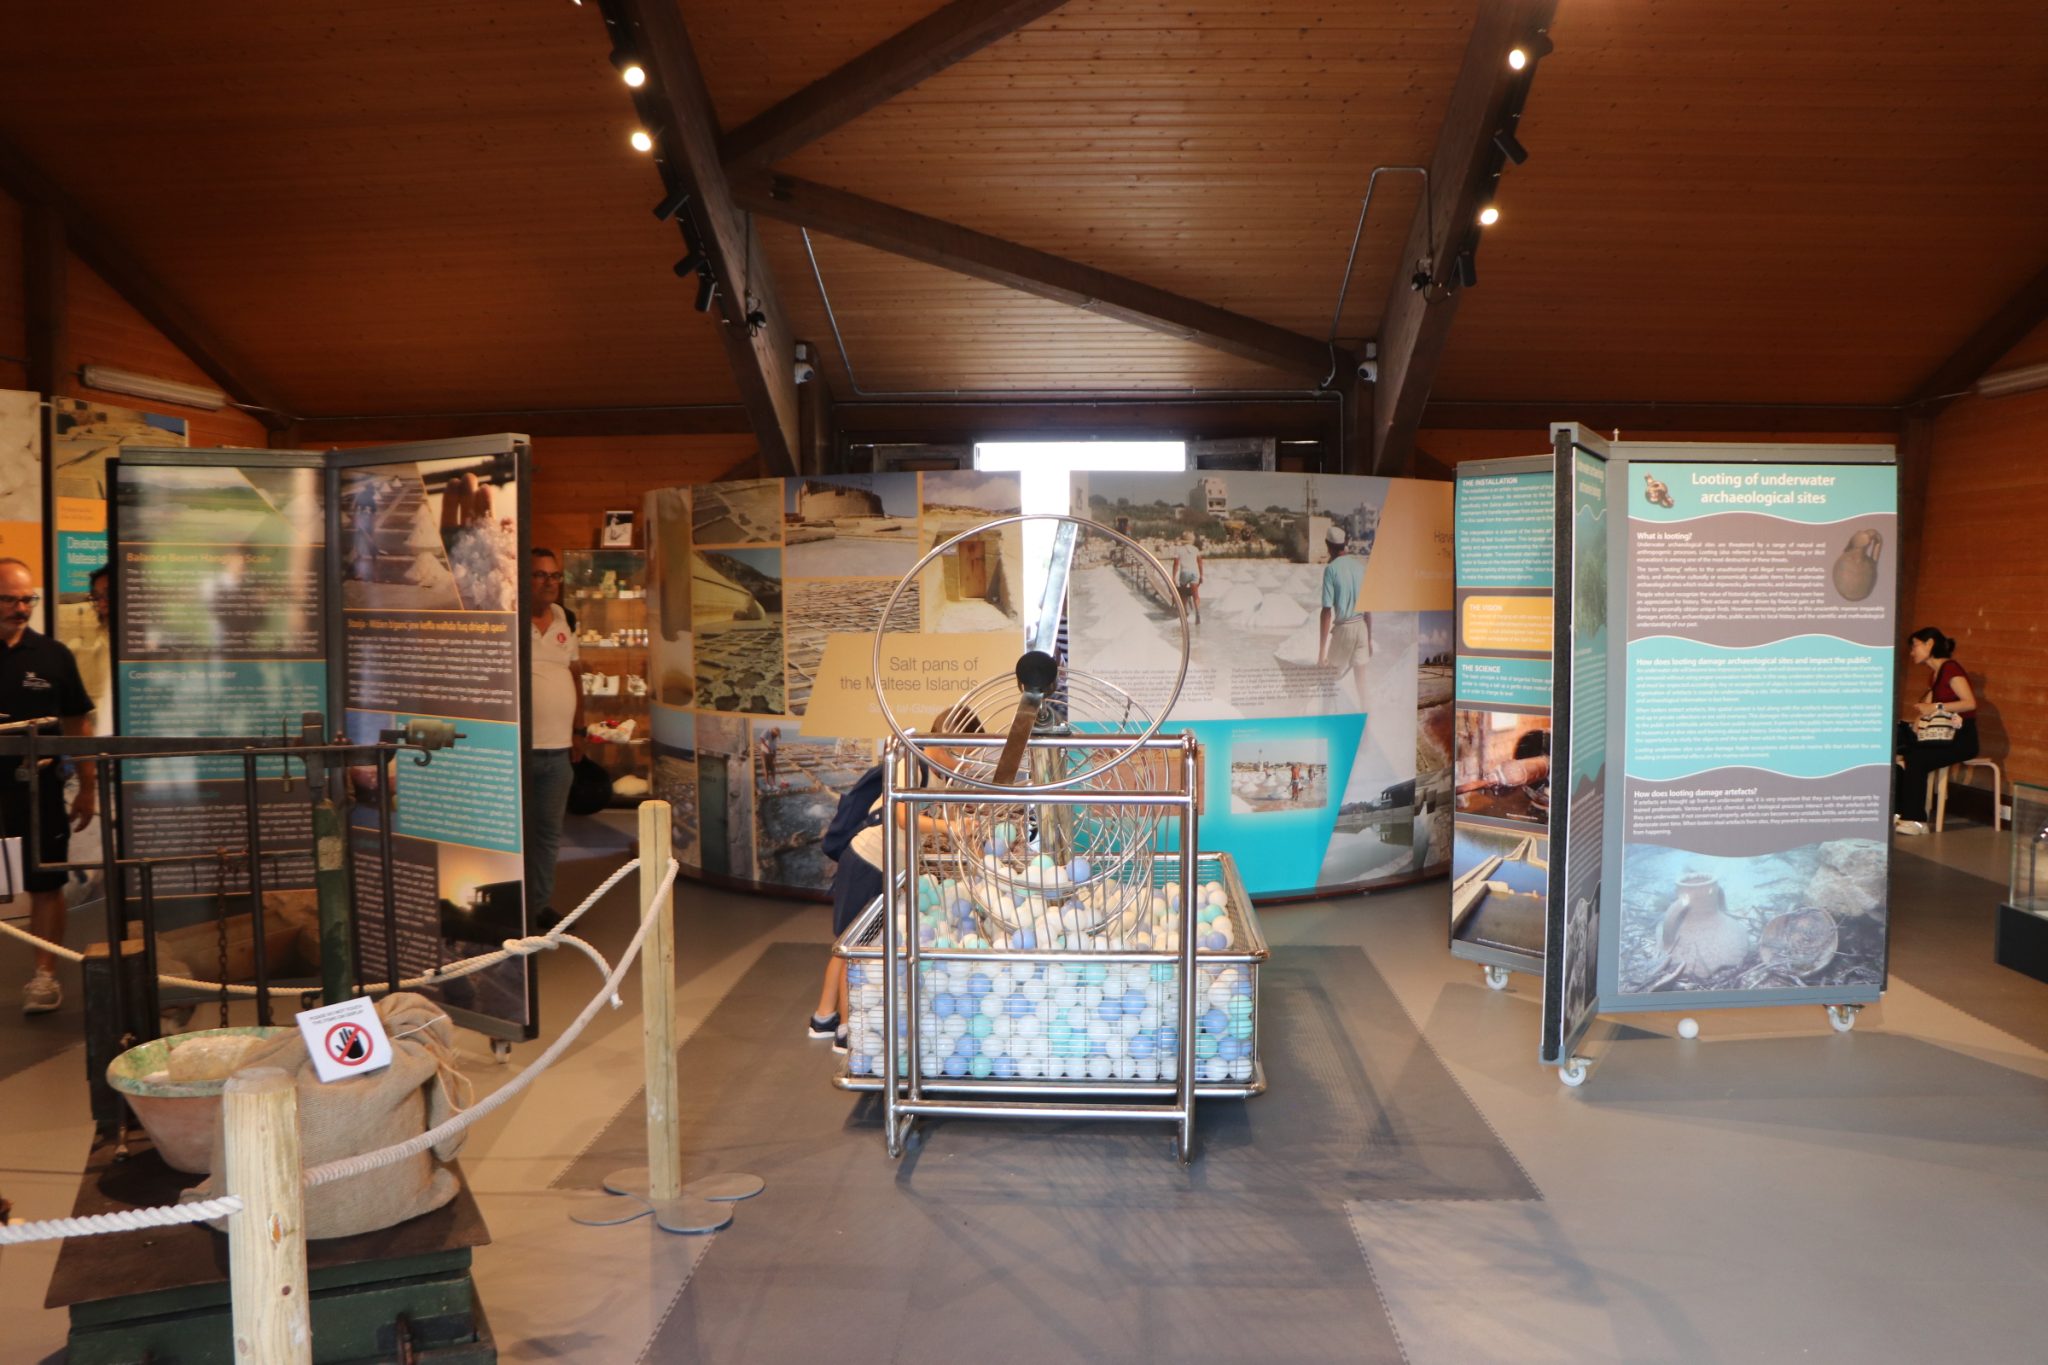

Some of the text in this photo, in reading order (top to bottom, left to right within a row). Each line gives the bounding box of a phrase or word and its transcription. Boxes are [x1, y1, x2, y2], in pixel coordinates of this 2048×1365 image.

[1463, 477, 1519, 487] THE INSTALLATION
[1692, 472, 1836, 488] Looting of underwater
[1701, 491, 1826, 506] archaeological sites
[1637, 532, 1693, 542] What is looting?
[890, 657, 979, 675] Salt pans of
[1636, 656, 1872, 667] How does looting damage archaeological sites and impact the public?
[1474, 665, 1501, 673] SCIENCE
[840, 675, 979, 691] the Maltese Islands
[1634, 788, 1758, 799] How does looting damage artefacts?
